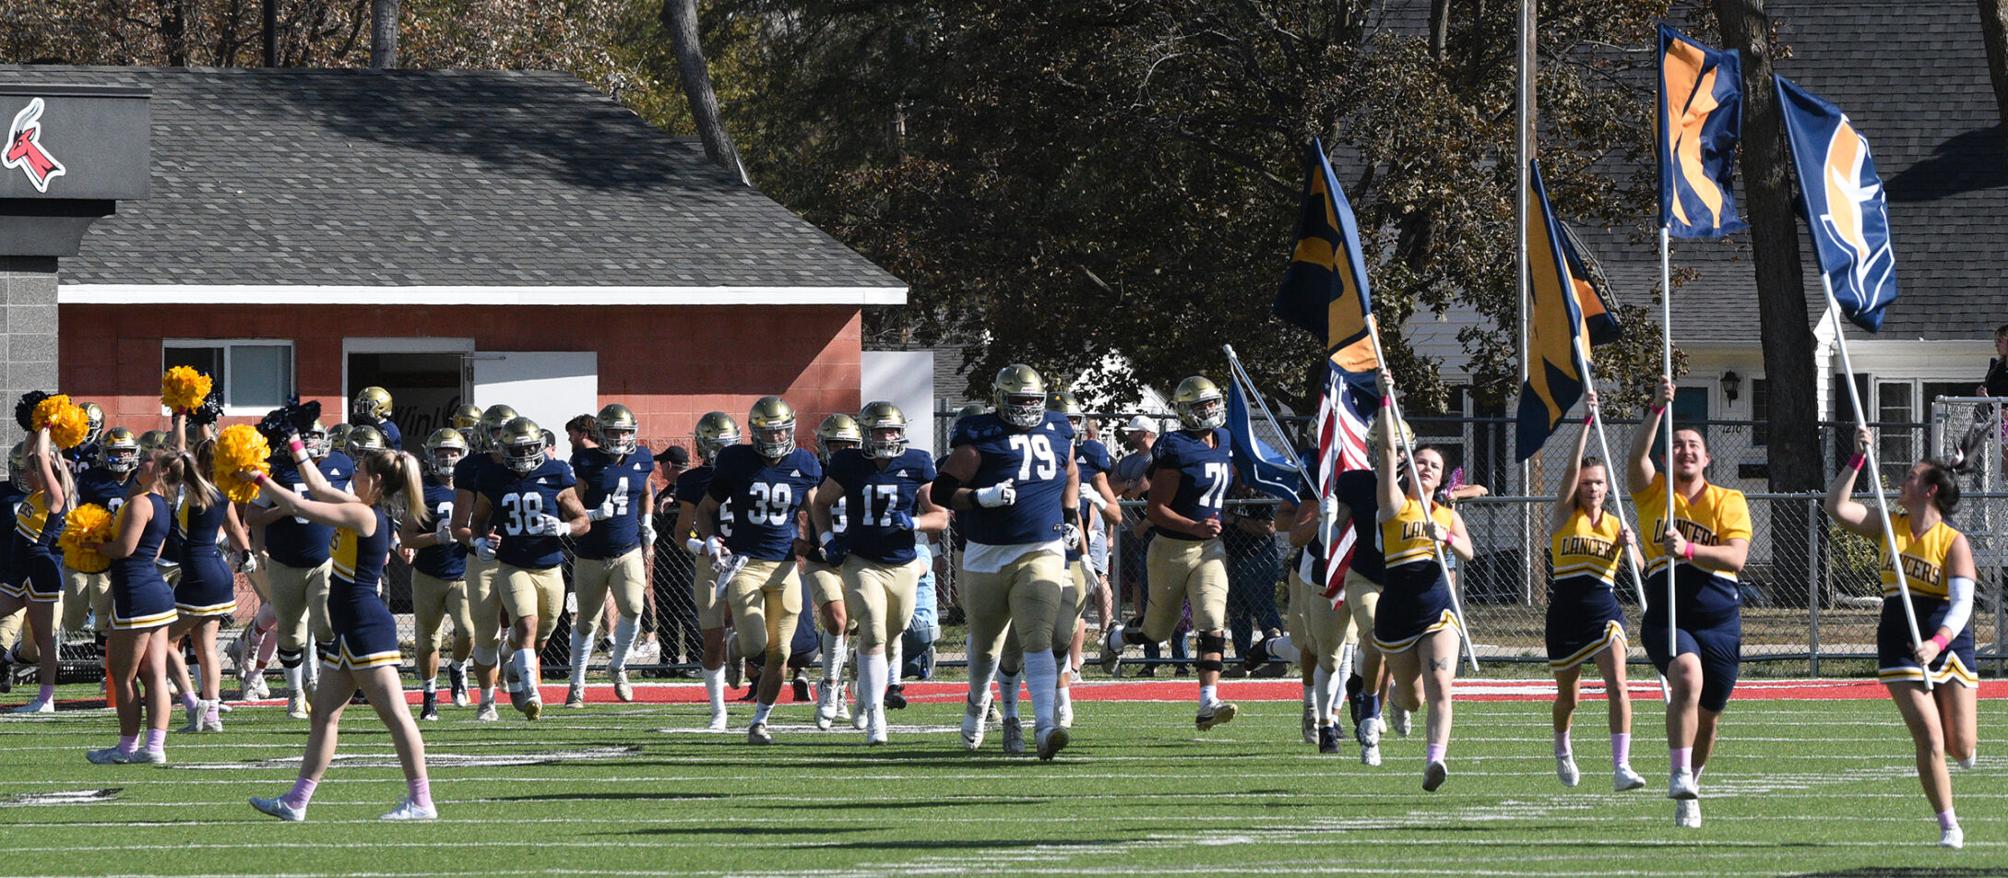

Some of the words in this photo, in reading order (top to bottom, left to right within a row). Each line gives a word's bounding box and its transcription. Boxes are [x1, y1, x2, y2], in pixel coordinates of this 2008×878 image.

[1009, 434, 1056, 480] 79
[612, 477, 629, 515] 4
[747, 482, 792, 526] 39
[862, 484, 898, 527] 17
[1199, 463, 1229, 508] 71
[501, 491, 545, 537] 38
[1560, 536, 1617, 562] LANCERS
